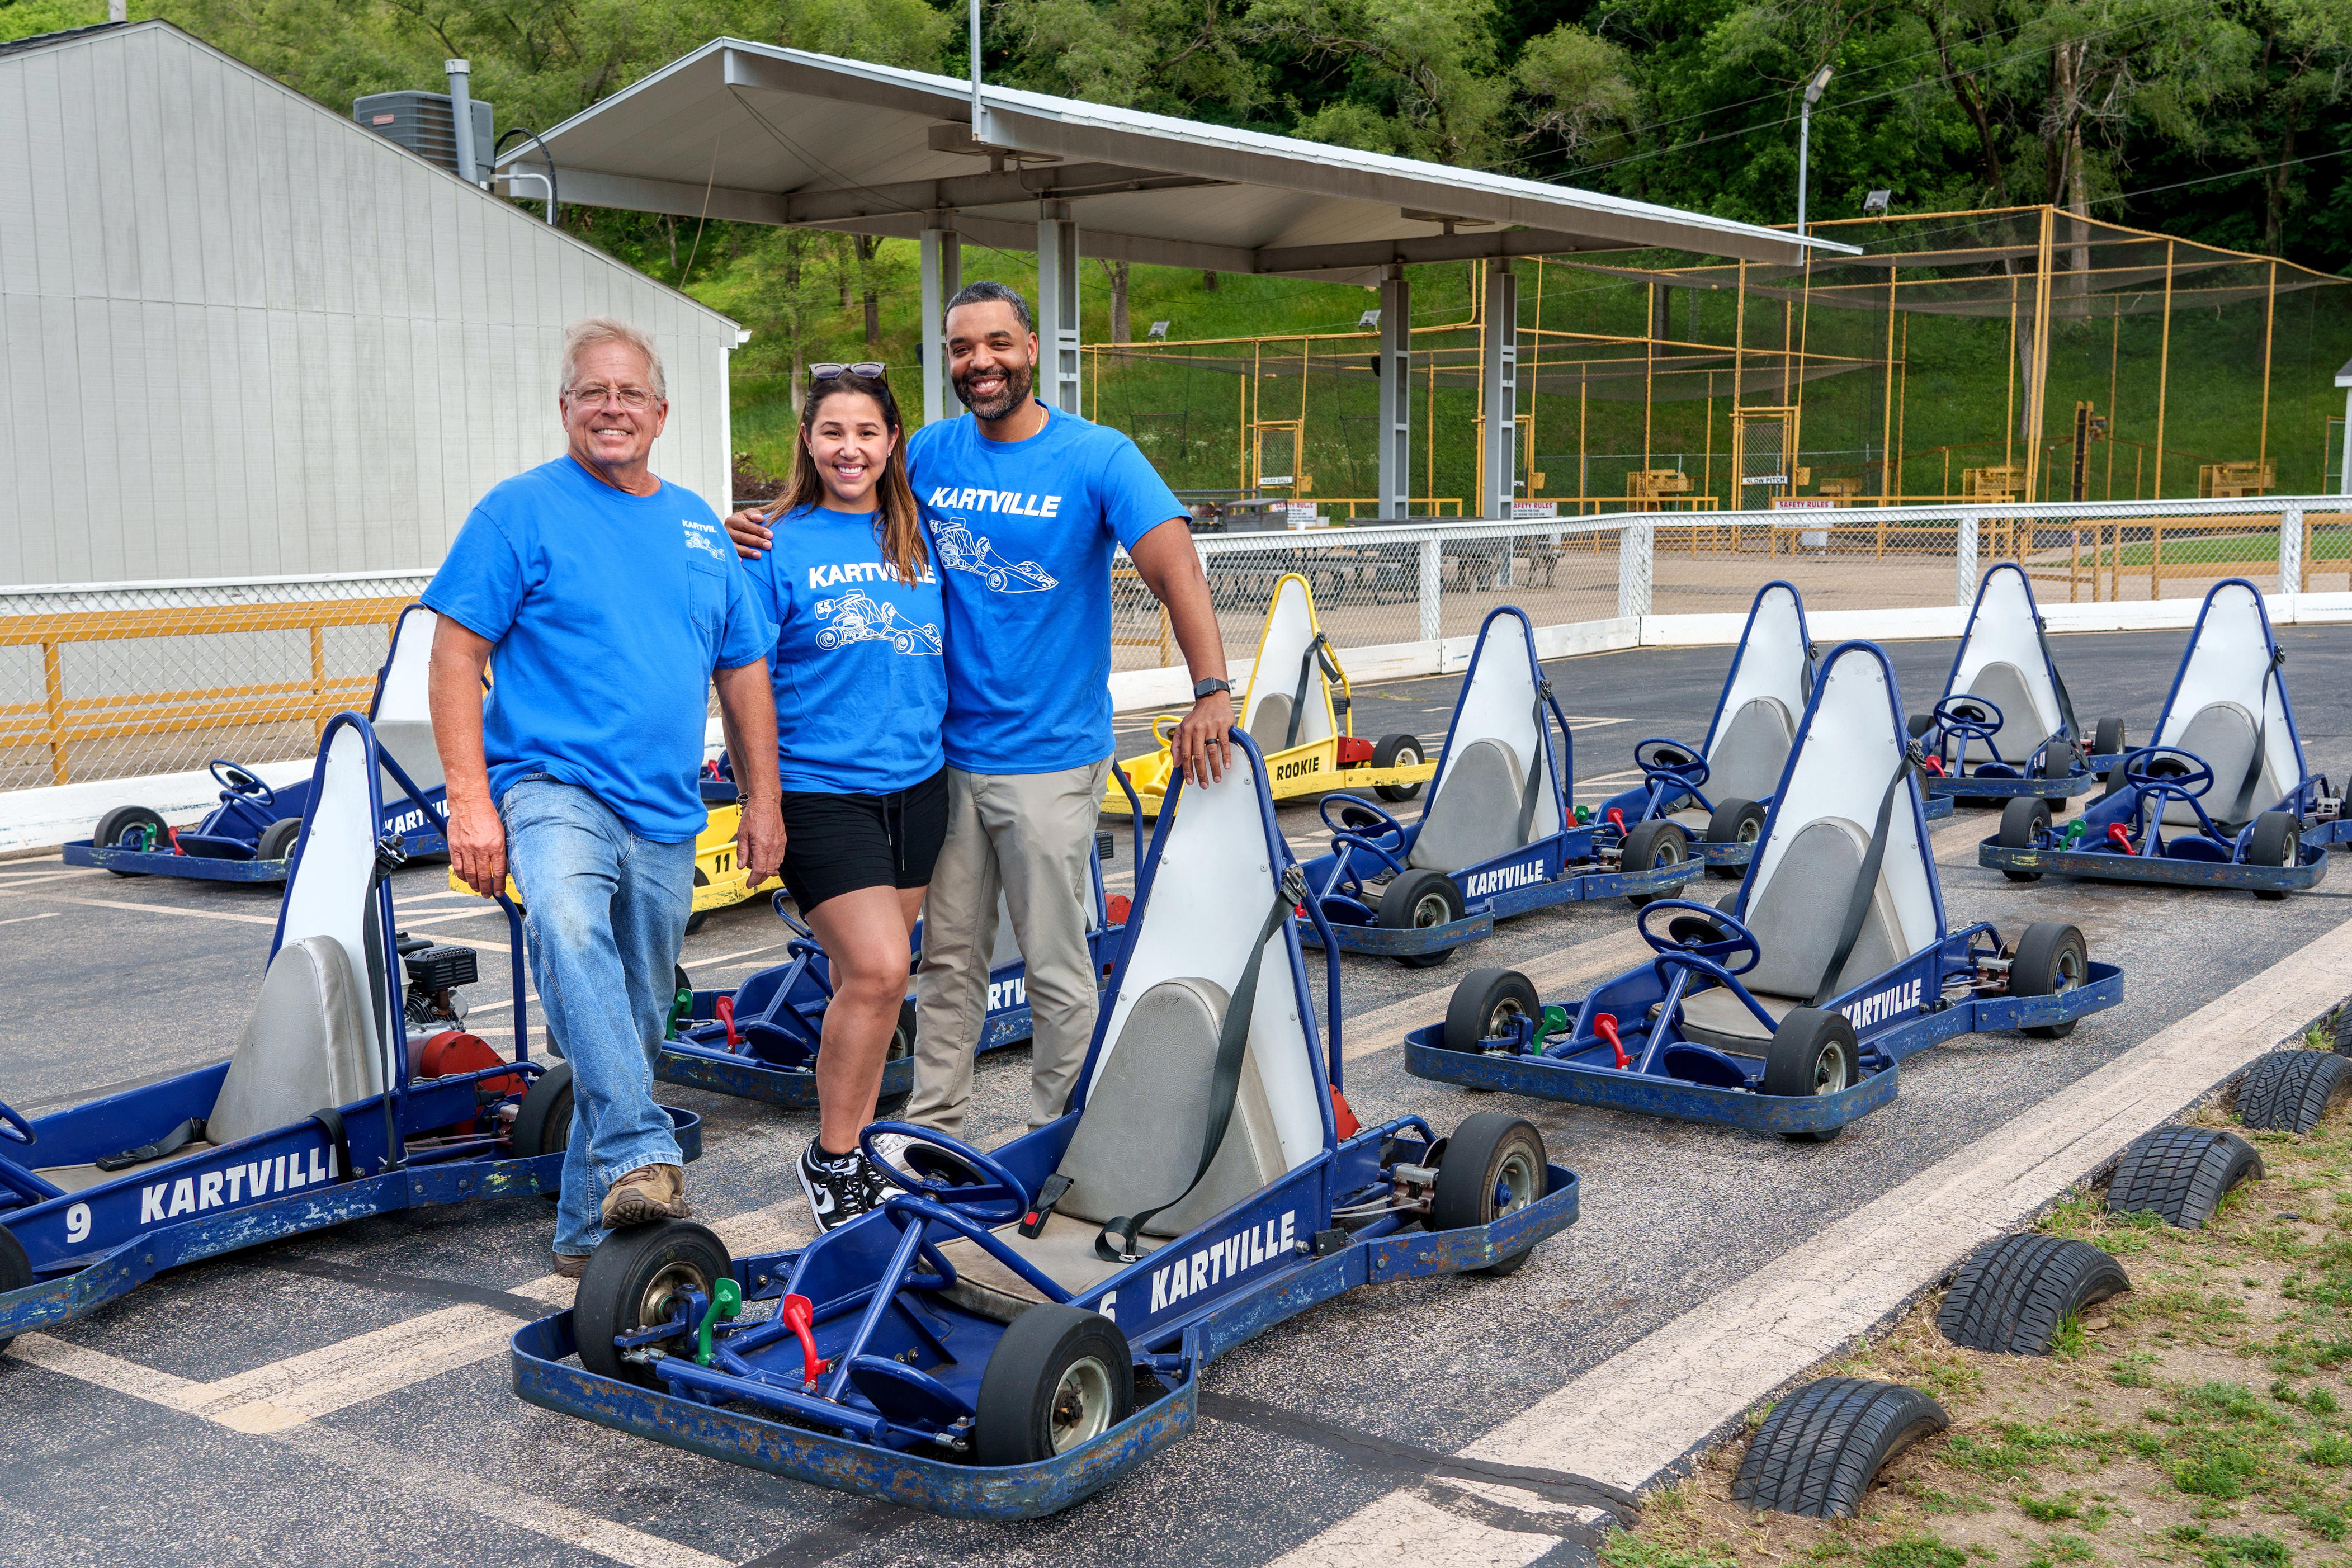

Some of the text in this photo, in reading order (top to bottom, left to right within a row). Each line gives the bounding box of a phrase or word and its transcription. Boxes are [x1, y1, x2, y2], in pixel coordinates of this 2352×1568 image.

[928, 487, 1061, 517] KARTVILLE
[682, 519, 717, 533] KARTVIL
[809, 563, 936, 589] KARTVILE
[817, 601, 832, 614] 55
[1277, 757, 1319, 780] ROOKIE
[715, 853, 730, 874] 11
[1467, 859, 1543, 898] KARTVILLE
[67, 1203, 91, 1243] 9
[1150, 1210, 1295, 1314] KARTVILLE
[1099, 1291, 1117, 1323] 6
